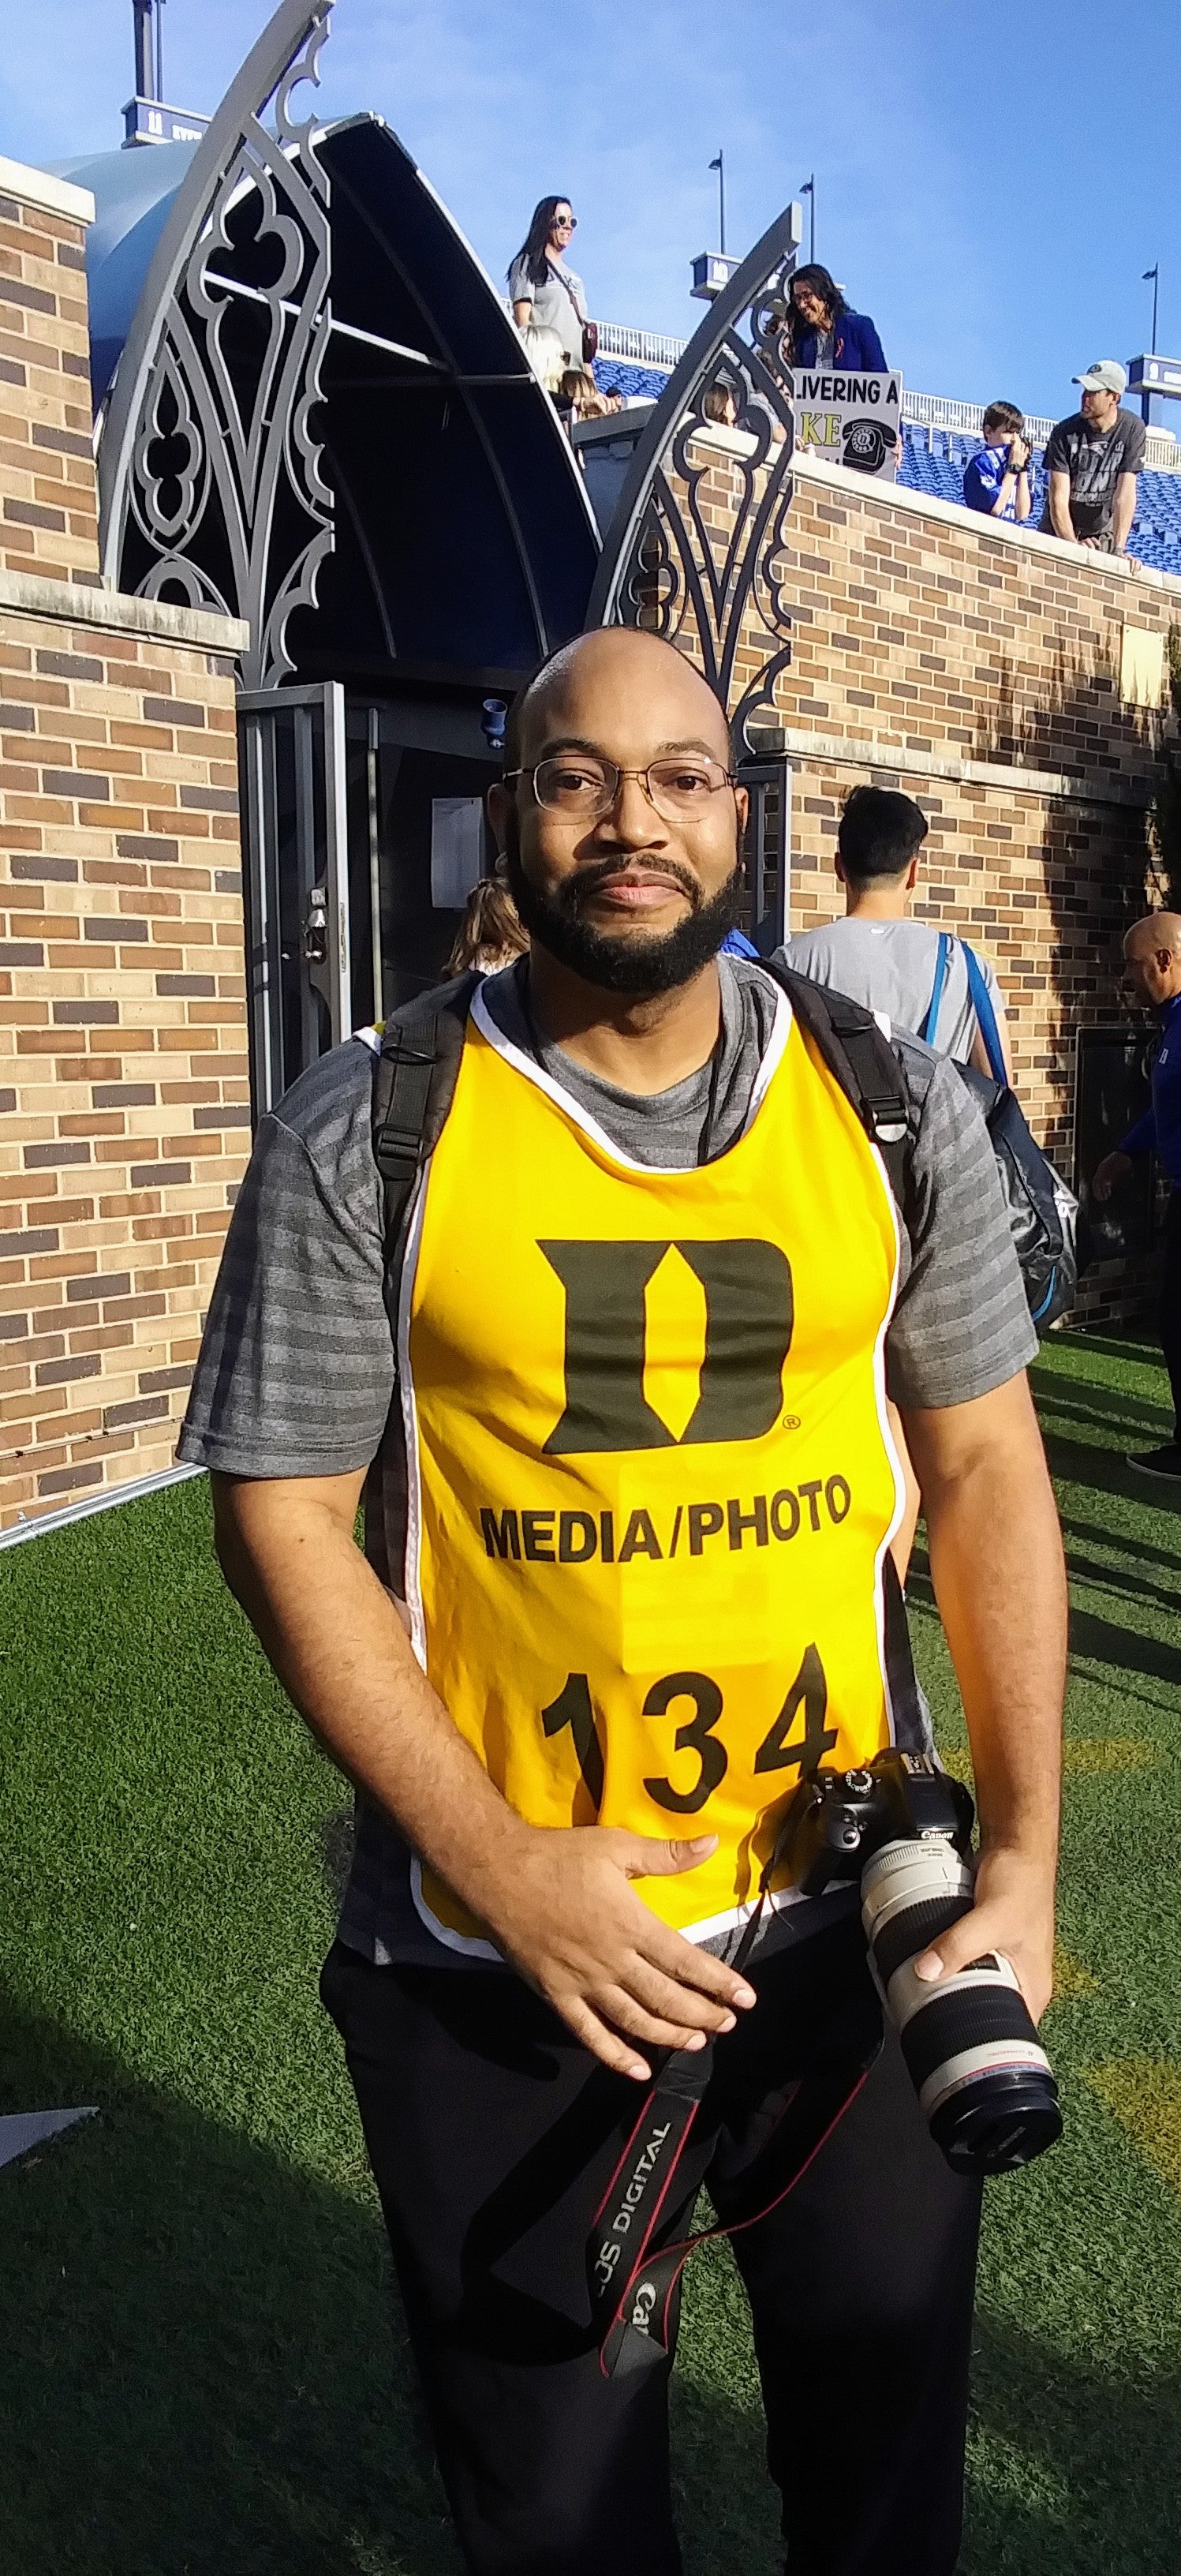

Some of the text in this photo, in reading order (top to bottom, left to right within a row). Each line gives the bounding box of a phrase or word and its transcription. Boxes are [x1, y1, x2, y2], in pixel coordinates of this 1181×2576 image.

[886, 380, 898, 404] A
[534, 1237, 794, 1455] D
[480, 1473, 852, 1563] MEDIA/PHOTO
[541, 1642, 839, 1814] 134
[921, 1830, 954, 1840] Canon
[594, 2121, 671, 2297] OS DIGITAL
